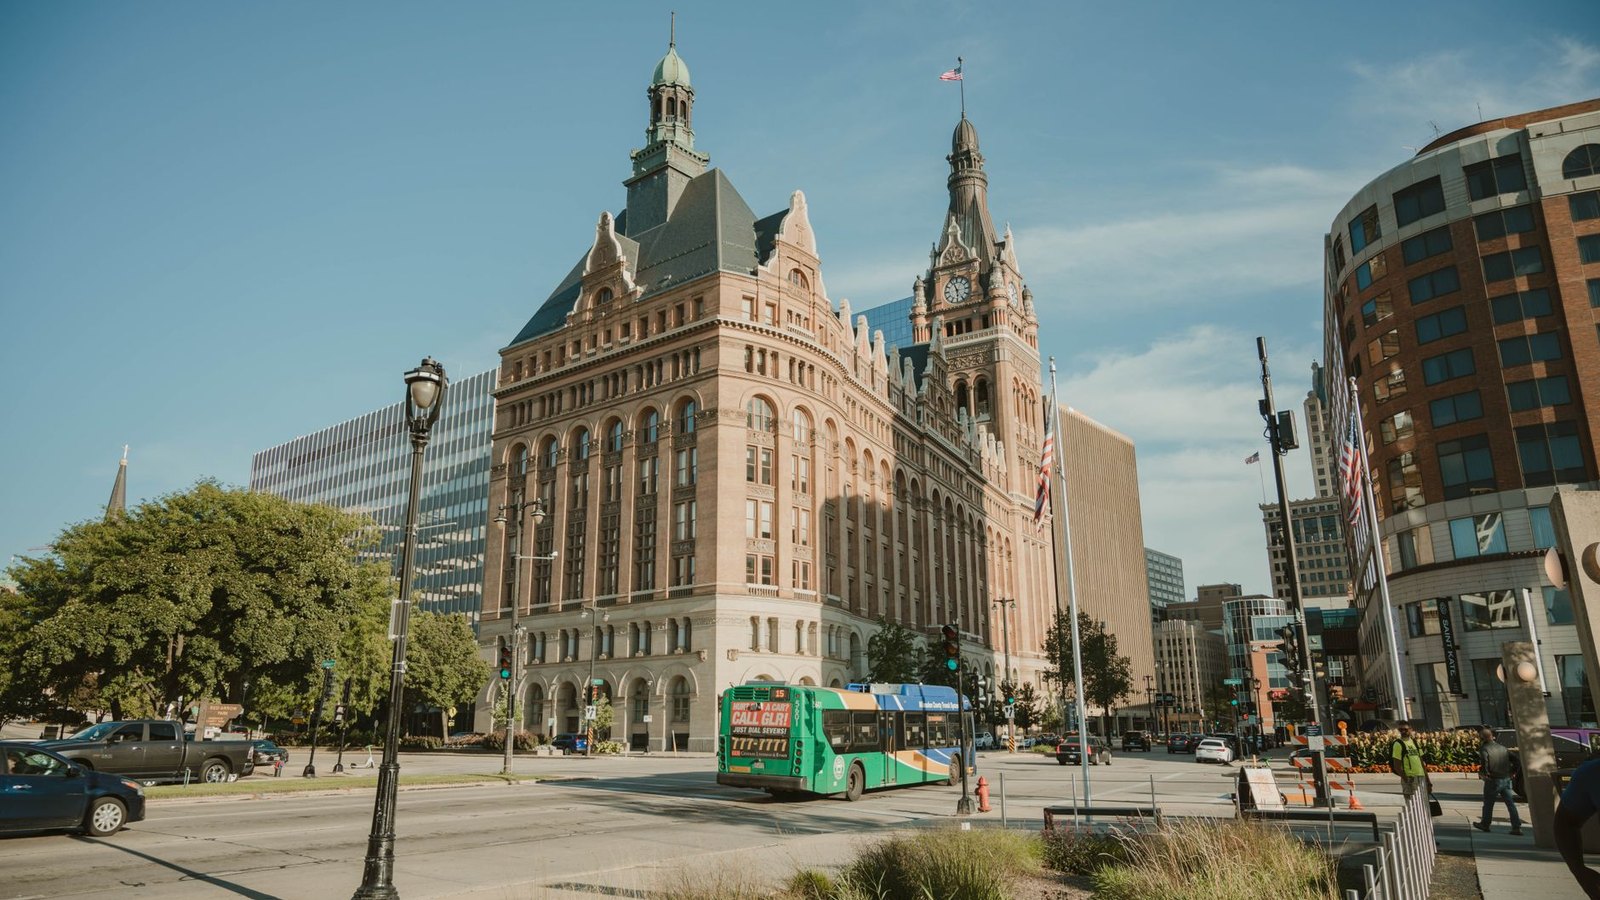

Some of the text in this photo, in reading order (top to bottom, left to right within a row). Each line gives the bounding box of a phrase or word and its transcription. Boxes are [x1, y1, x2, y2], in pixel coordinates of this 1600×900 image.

[1442, 619, 1452, 648] SAINT
[1447, 650, 1456, 677] KATE
[775, 689, 784, 698] 15
[732, 711, 788, 726] CALL GLR!
[733, 726, 748, 734] JUST
[762, 727, 788, 735] SEVENS!
[731, 736, 787, 751] 777-7777
